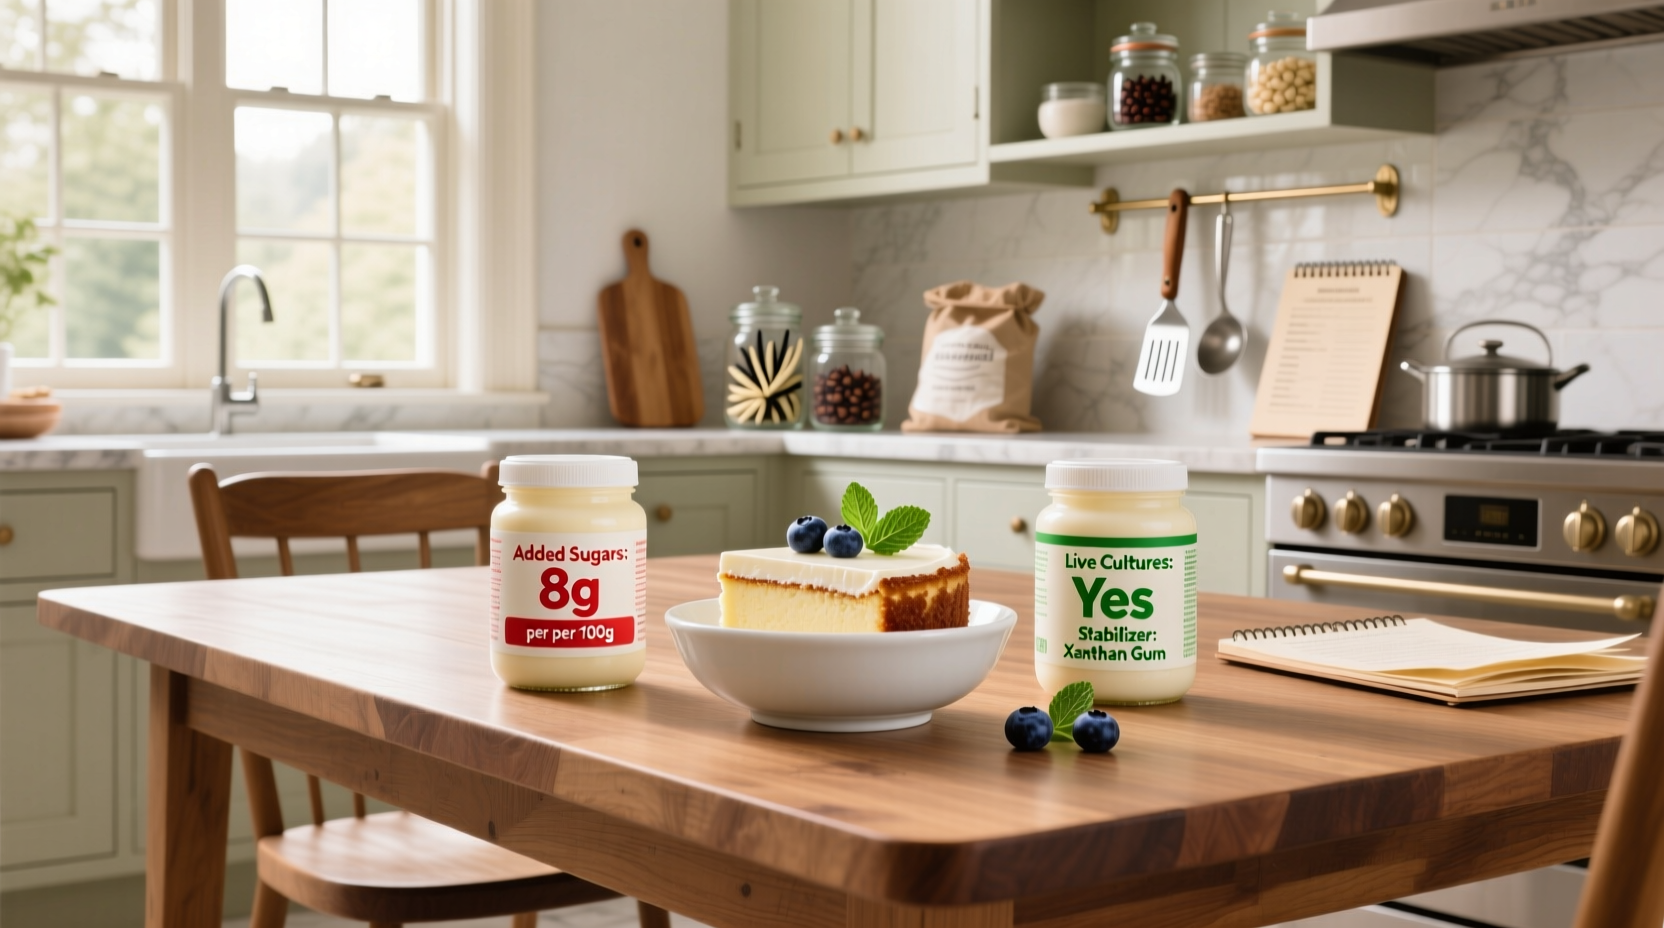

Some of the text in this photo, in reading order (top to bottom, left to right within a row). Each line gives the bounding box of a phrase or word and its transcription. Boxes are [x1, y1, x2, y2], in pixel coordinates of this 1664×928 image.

[513, 544, 628, 566] Added Sugars:
[1065, 553, 1173, 570] Live Cultures:
[539, 567, 600, 618] 8g
[1071, 576, 1154, 620] Yes
[526, 625, 614, 644] per per 100g
[1078, 626, 1157, 642] Stabilizer:
[1063, 643, 1127, 661] Xanthan
[1131, 645, 1166, 661] Gum
